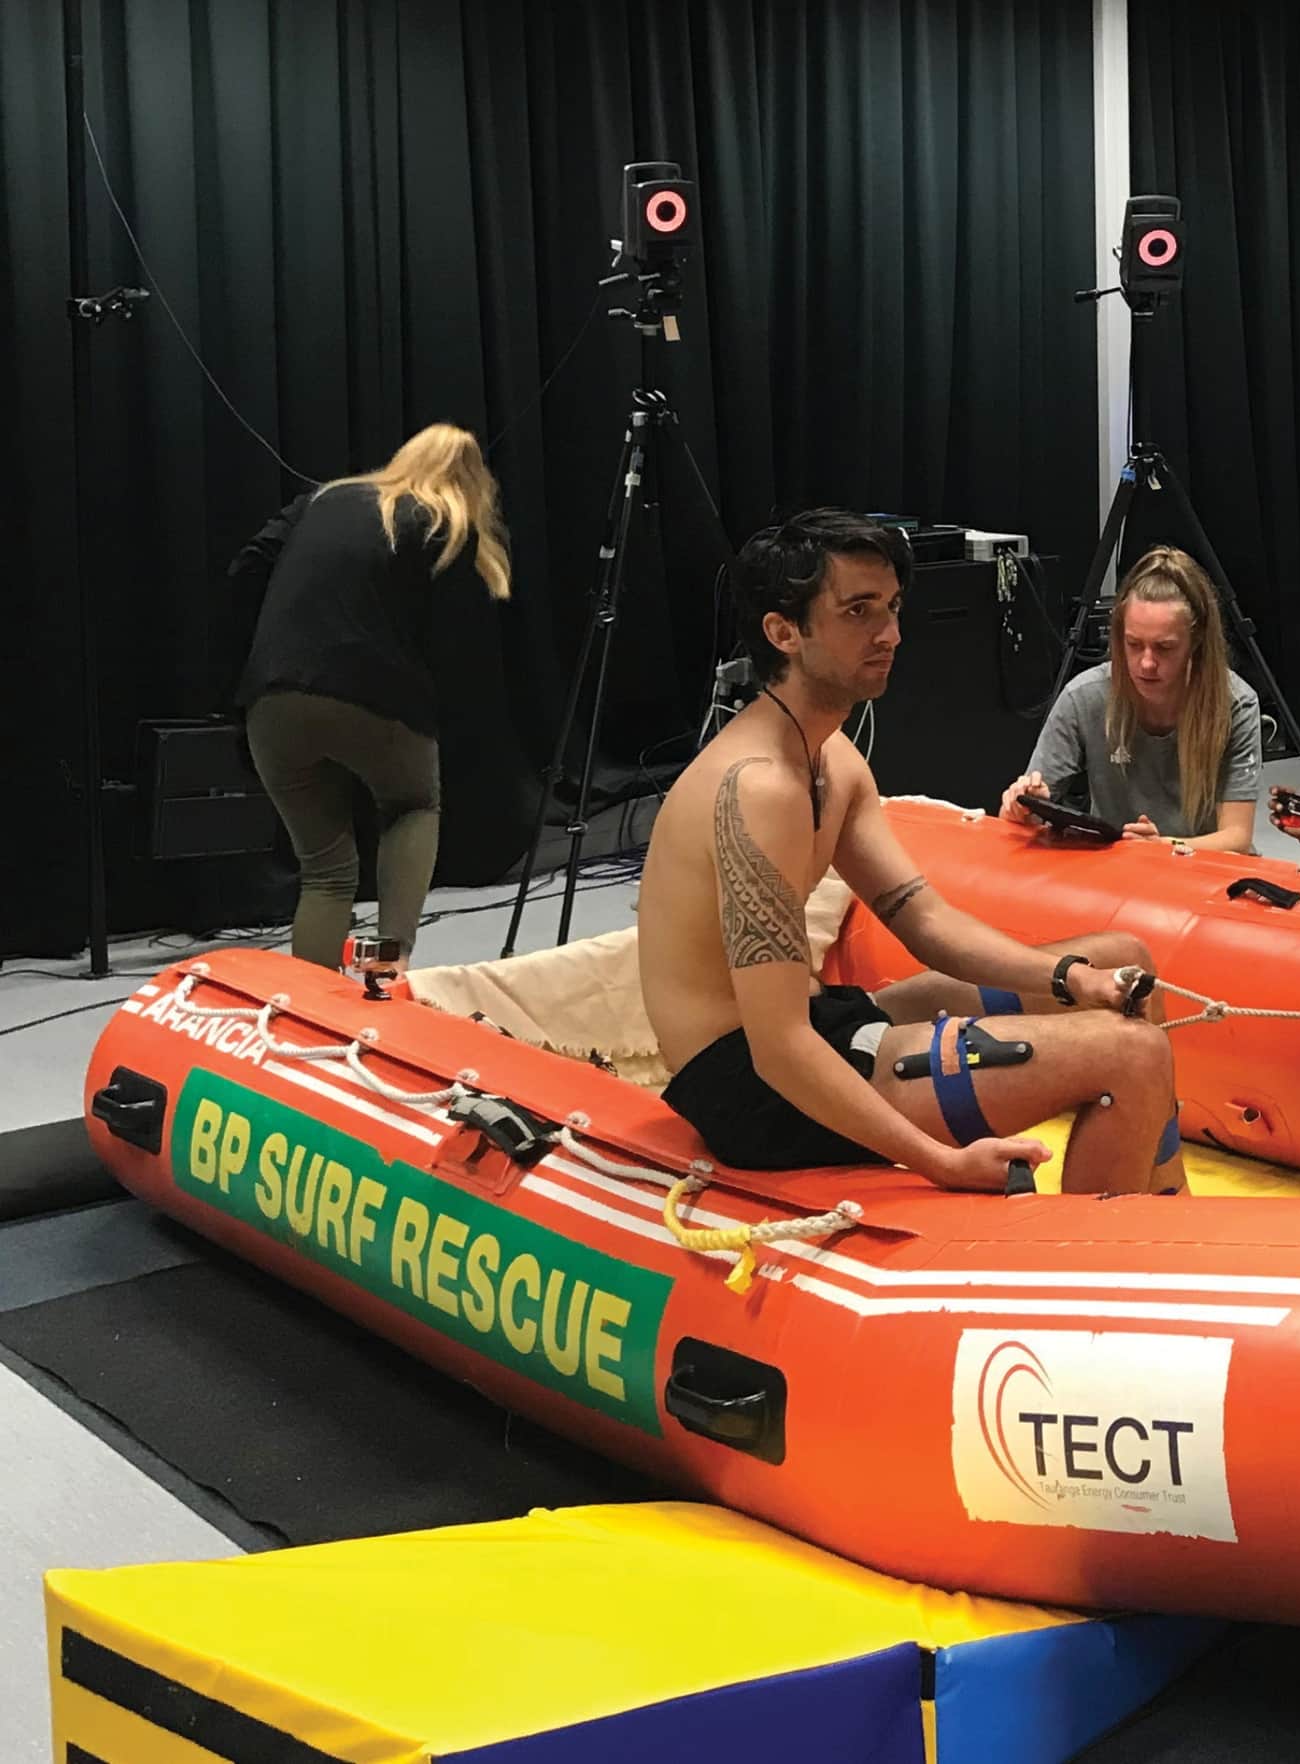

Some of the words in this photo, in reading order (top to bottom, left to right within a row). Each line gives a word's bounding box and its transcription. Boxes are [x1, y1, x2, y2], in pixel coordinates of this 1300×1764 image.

[190, 1098, 252, 1190] BP
[254, 1132, 388, 1266] SURF
[391, 1196, 632, 1401] RESCUE
[1019, 1412, 1193, 1486] TECT
[1081, 1484, 1113, 1500] Energy
[1114, 1487, 1161, 1502] Consumer
[1163, 1490, 1187, 1504] Trust
